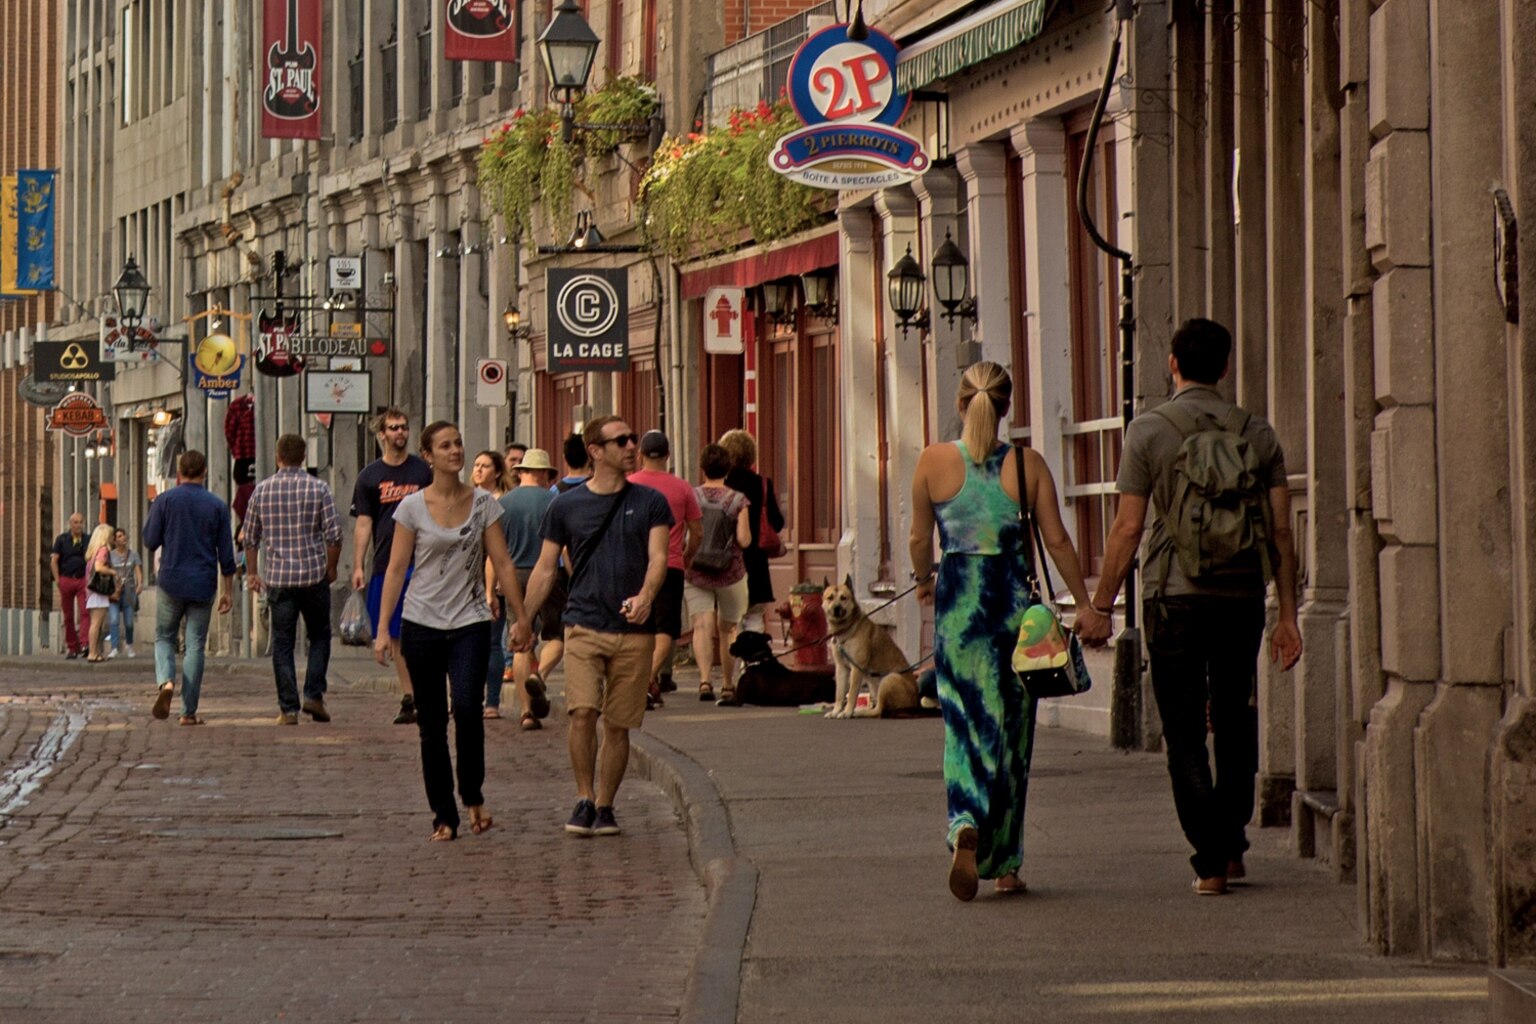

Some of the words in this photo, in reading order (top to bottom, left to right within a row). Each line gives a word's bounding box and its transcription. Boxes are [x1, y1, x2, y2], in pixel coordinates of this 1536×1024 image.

[287, 68, 315, 103] PAUL
[813, 52, 890, 121] 2P
[804, 134, 819, 155] 2
[820, 133, 900, 155] PIERROTS
[802, 171, 829, 184] BOÎTE
[841, 171, 900, 186] SPECTACLES
[291, 338, 367, 355] BILODEAU
[553, 343, 573, 357] LA
[579, 343, 623, 357] CAGE
[198, 376, 238, 388] Amber
[63, 409, 94, 420] KEBAB
